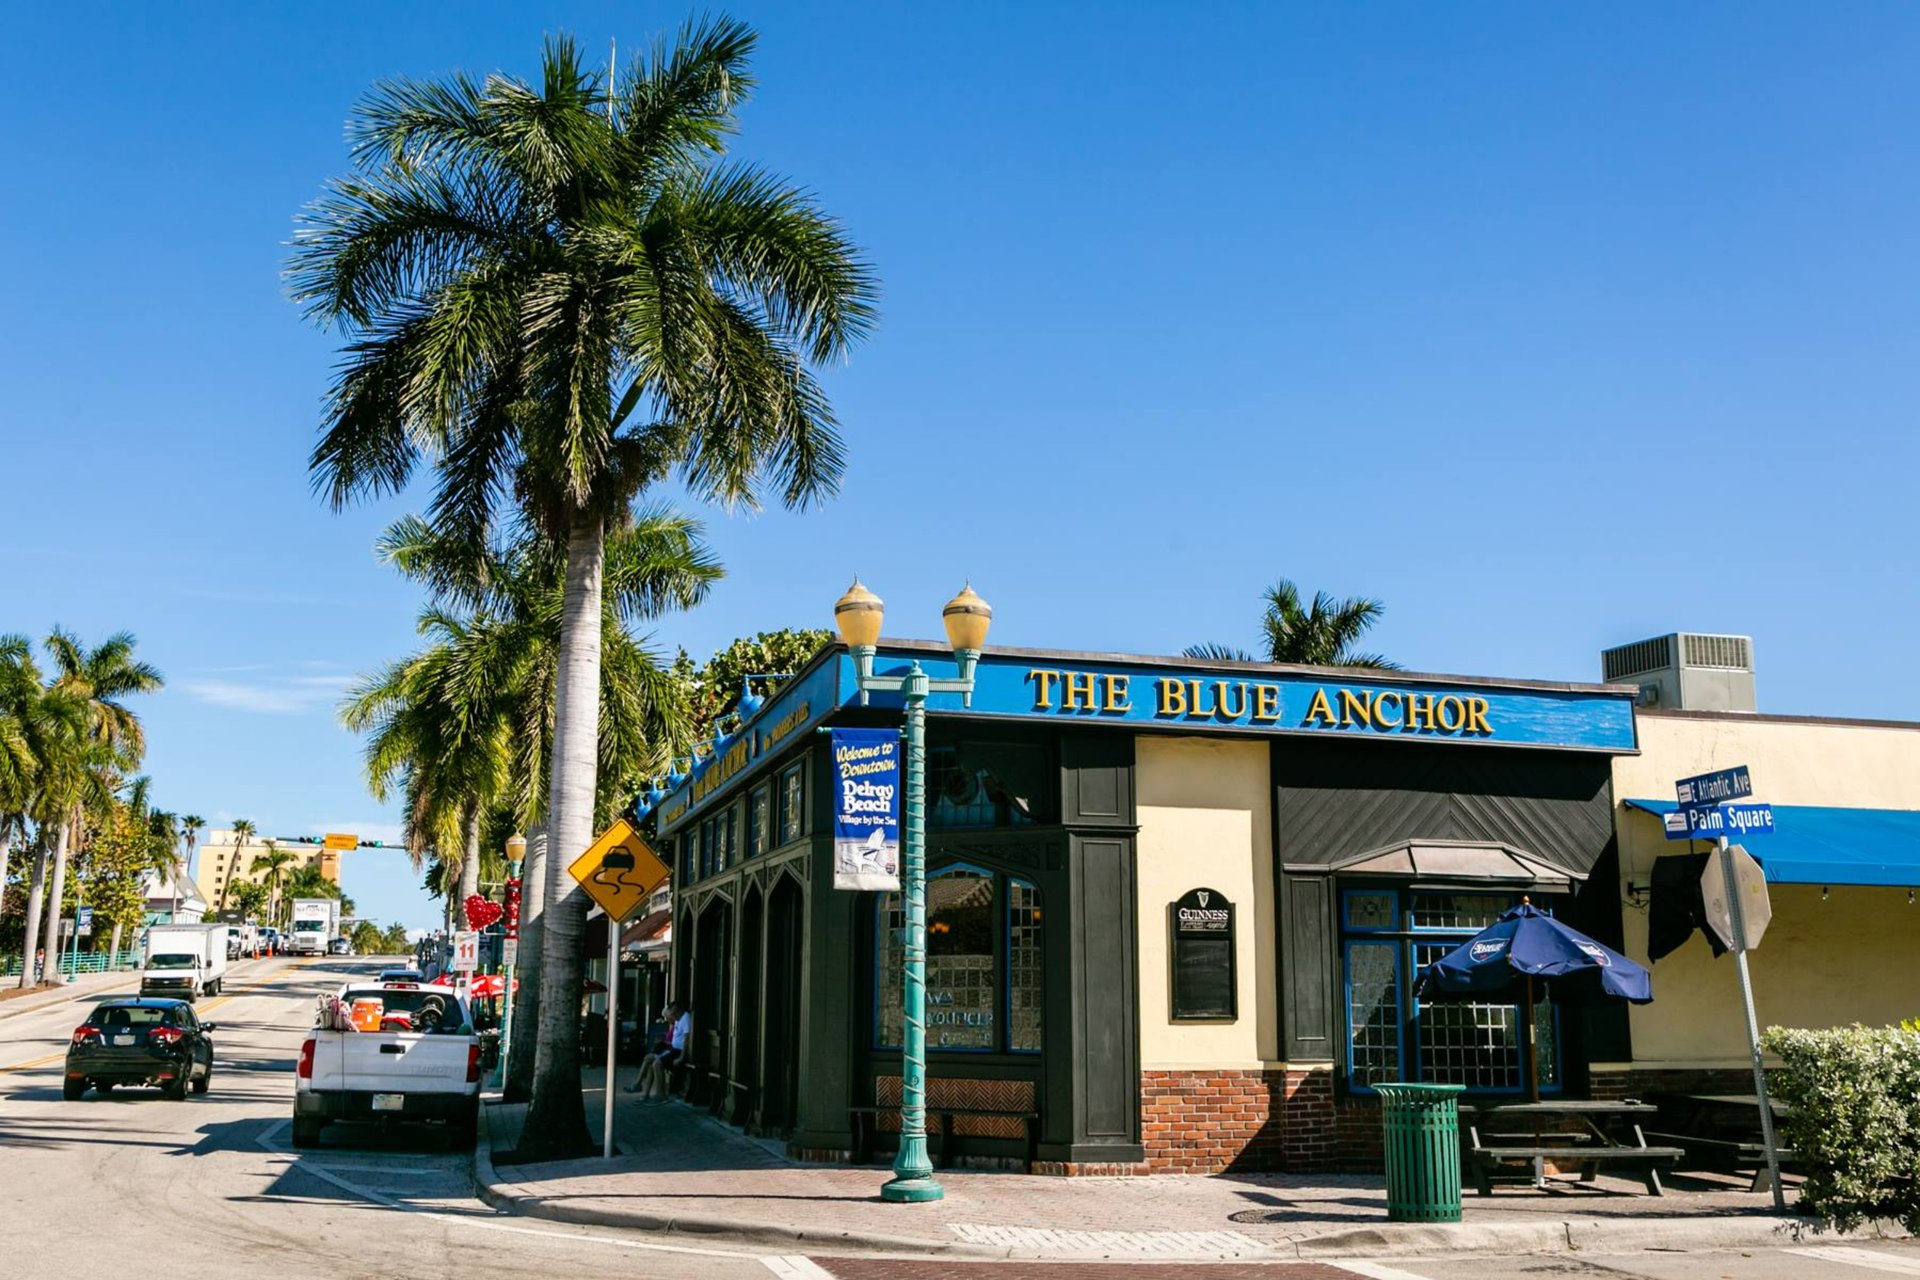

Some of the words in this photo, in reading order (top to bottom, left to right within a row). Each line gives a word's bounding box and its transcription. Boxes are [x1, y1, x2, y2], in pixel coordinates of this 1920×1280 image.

[1029, 668, 1133, 713] THE
[1158, 677, 1282, 721] BLUE
[1305, 687, 1495, 734] ANCHOR
[836, 745, 880, 763] Welcome
[881, 742, 894, 756] to
[839, 759, 896, 778] Downtown
[842, 780, 894, 800] Delray
[1691, 782, 1698, 803] E
[1698, 775, 1731, 801] Atlantic
[1733, 771, 1750, 794] Ave
[843, 796, 891, 814] Beach
[838, 814, 862, 827] Village
[863, 815, 873, 826] by
[873, 815, 884, 825] the
[884, 815, 897, 826] Sea
[1689, 809, 1724, 831] Palm
[1727, 806, 1773, 835] Square
[1179, 908, 1229, 920] GUINNESS
[459, 943, 475, 959] 11
